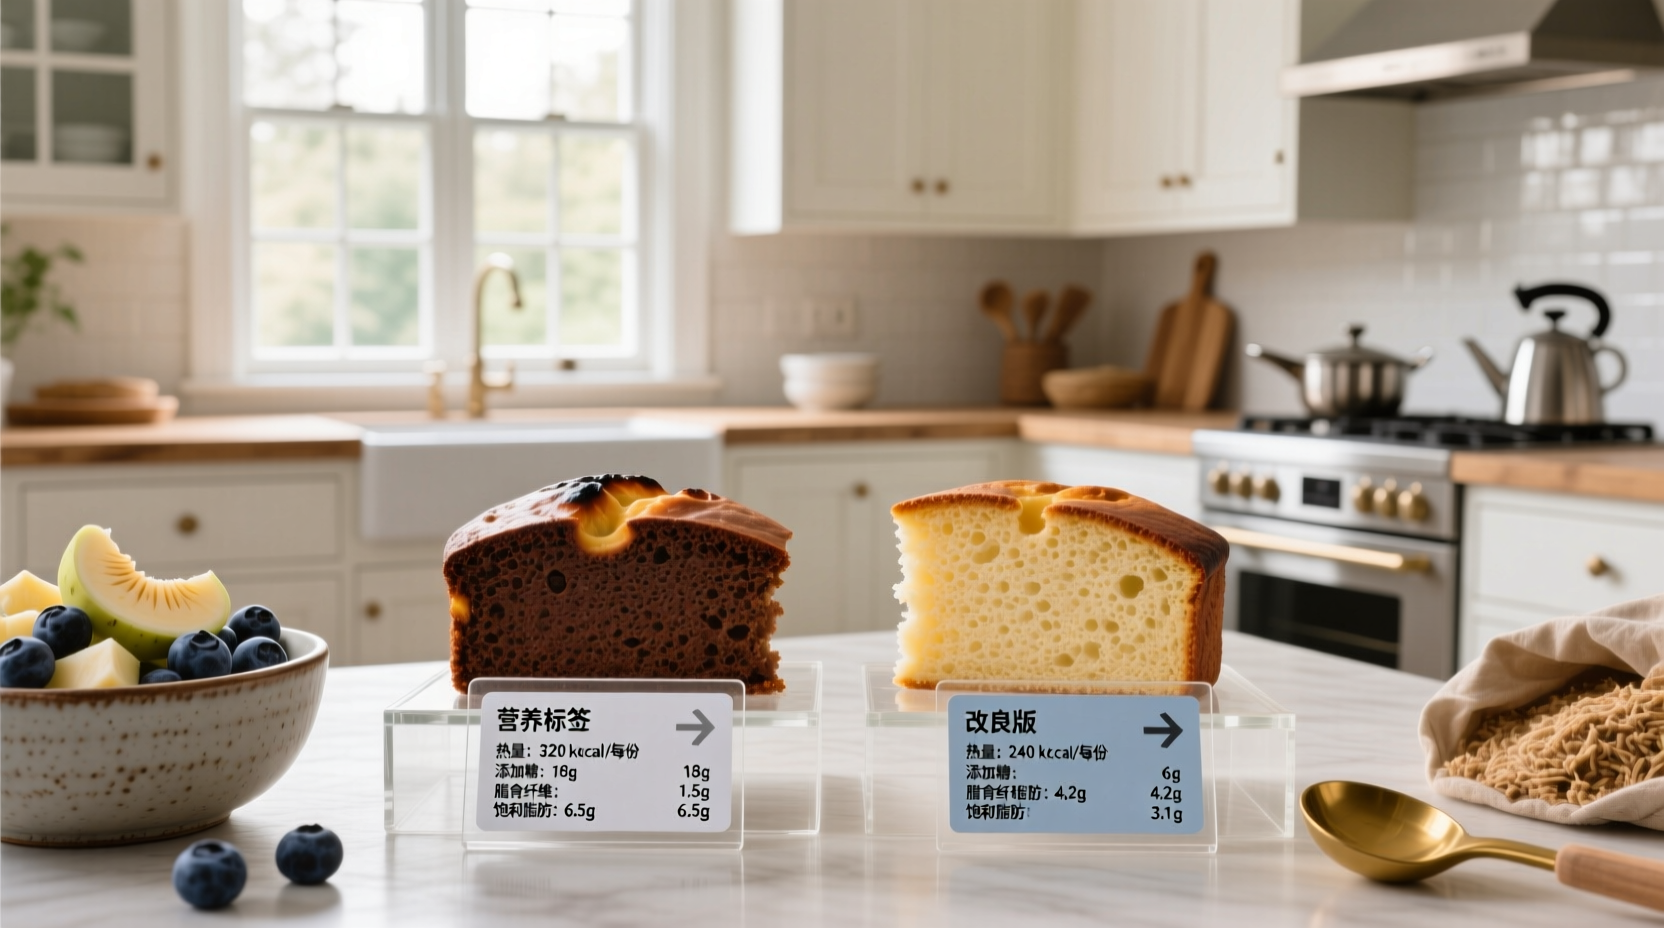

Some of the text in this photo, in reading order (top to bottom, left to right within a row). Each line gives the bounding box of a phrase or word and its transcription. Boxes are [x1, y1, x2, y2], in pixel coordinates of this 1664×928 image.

[497, 707, 592, 733] 营养标签
[965, 709, 1037, 734] 改良版
[539, 744, 566, 758] 320
[1008, 745, 1035, 759] 240
[683, 764, 710, 782] 18g
[1161, 765, 1181, 784] 6g
[679, 783, 710, 801] 1.5g
[1053, 785, 1087, 804] 4.2g
[1150, 785, 1183, 804] 4.2g
[564, 802, 596, 822] 6.5g
[677, 802, 710, 822] 6.5g
[1150, 805, 1183, 824] 3.1g
